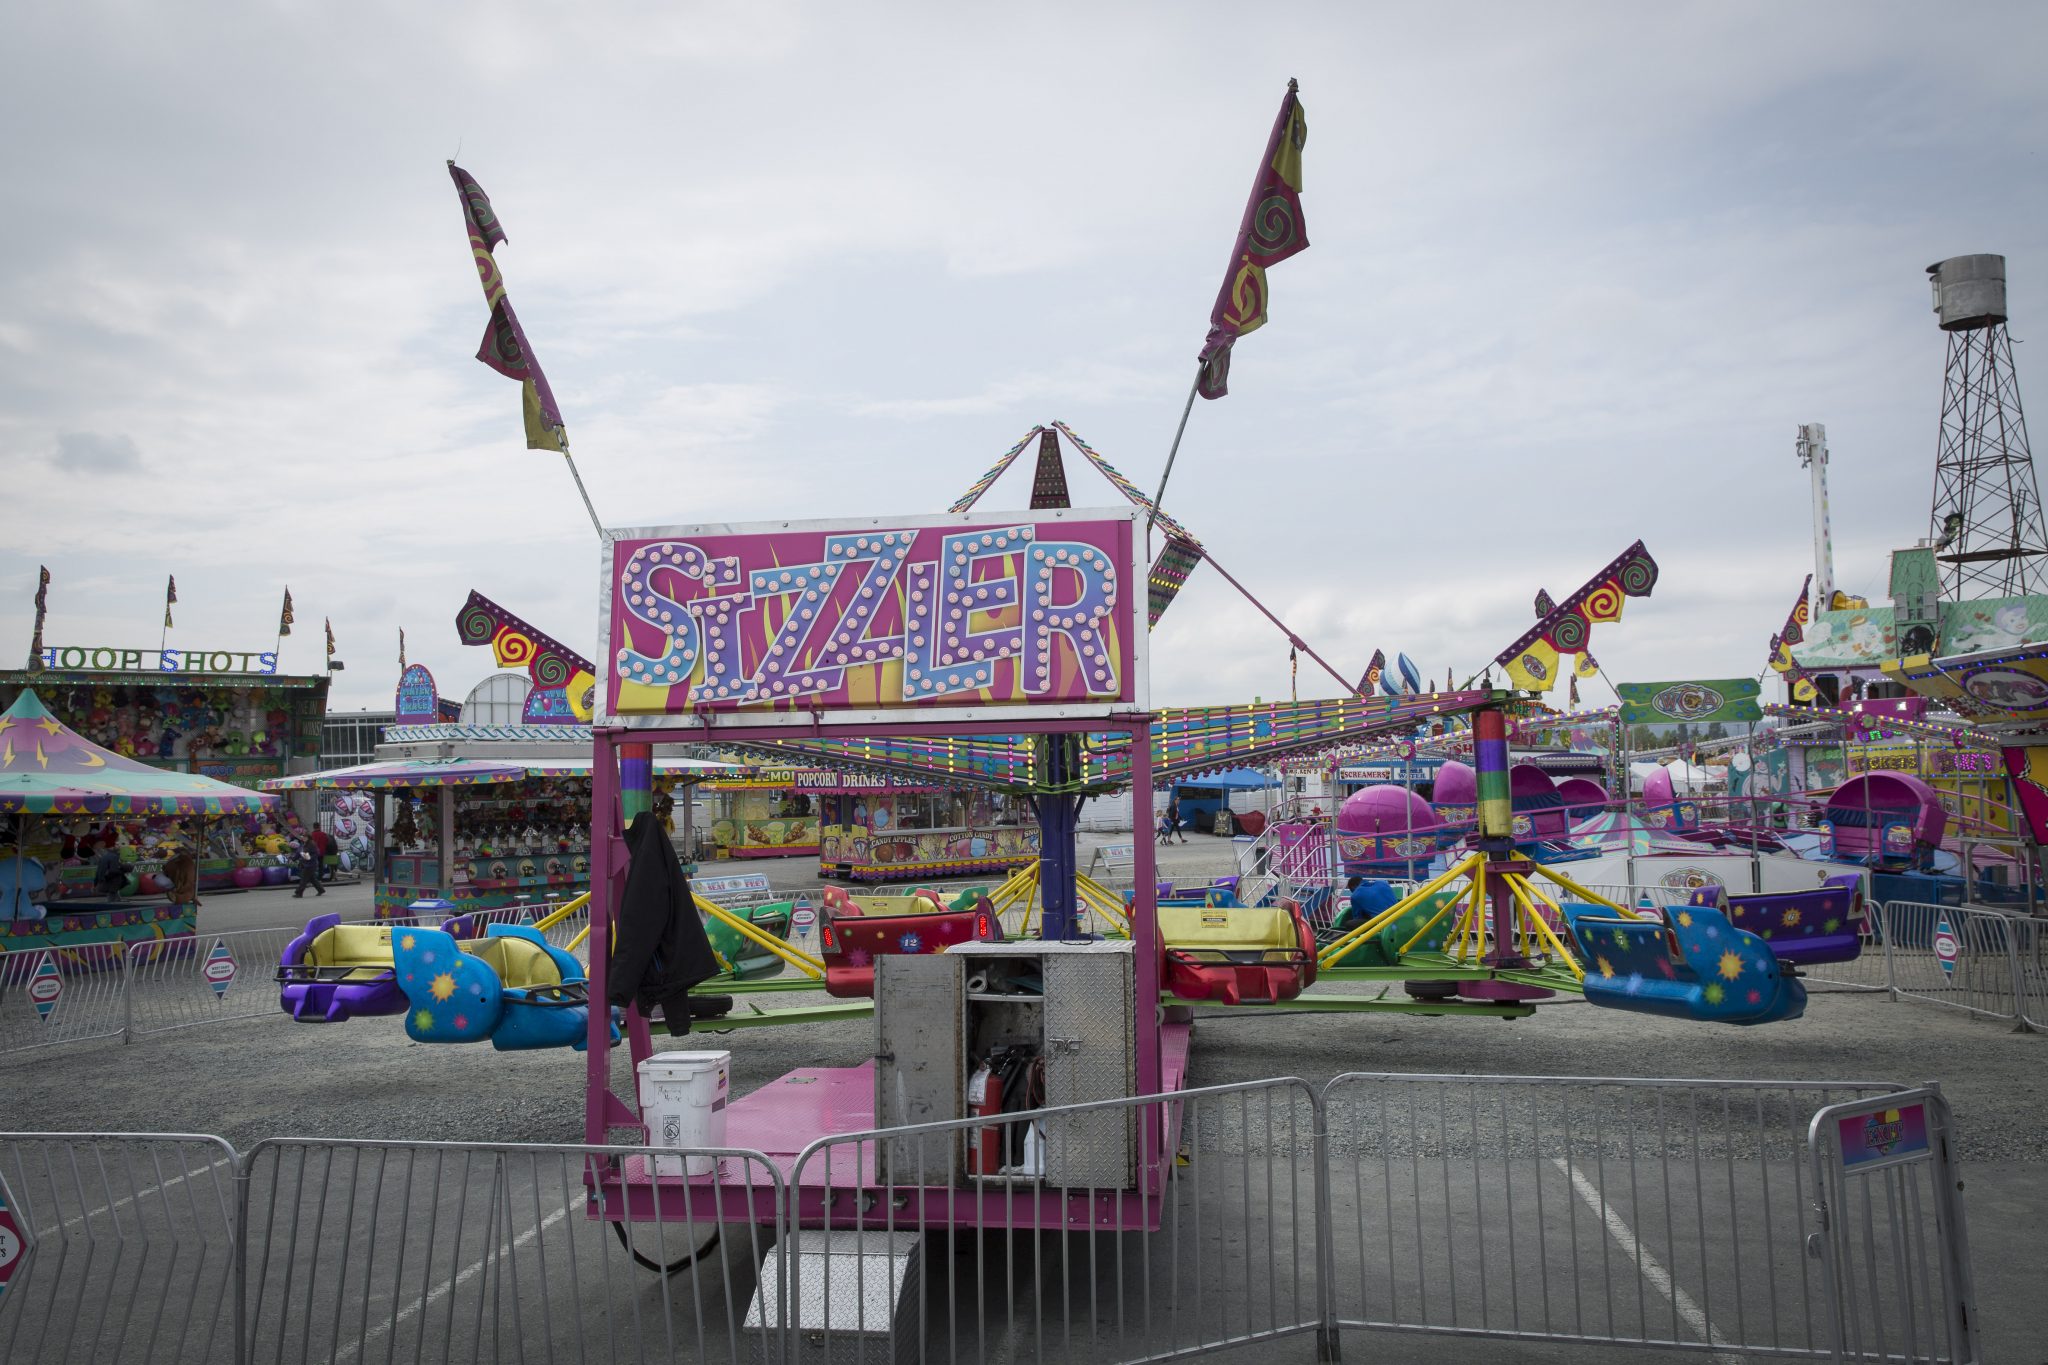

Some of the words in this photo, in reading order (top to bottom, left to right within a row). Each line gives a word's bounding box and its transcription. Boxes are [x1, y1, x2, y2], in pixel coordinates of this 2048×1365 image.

[617, 524, 1117, 706] SIZZLER
[41, 646, 140, 672] HOOP
[160, 649, 277, 675] SHOTS
[1851, 755, 1917, 772] TCKETS
[797, 771, 838, 788] POPCORN
[842, 772, 886, 788] DRINKS
[1344, 771, 1387, 779] SCREAMERS
[871, 836, 892, 846] CANDY
[892, 835, 917, 845] APPLES
[949, 832, 973, 841] COTTON
[974, 831, 993, 841] CANDY
[249, 858, 266, 866] ONE
[267, 858, 277, 866] IN
[904, 938, 917, 947] 12
[1864, 1121, 1904, 1148] EXIT
